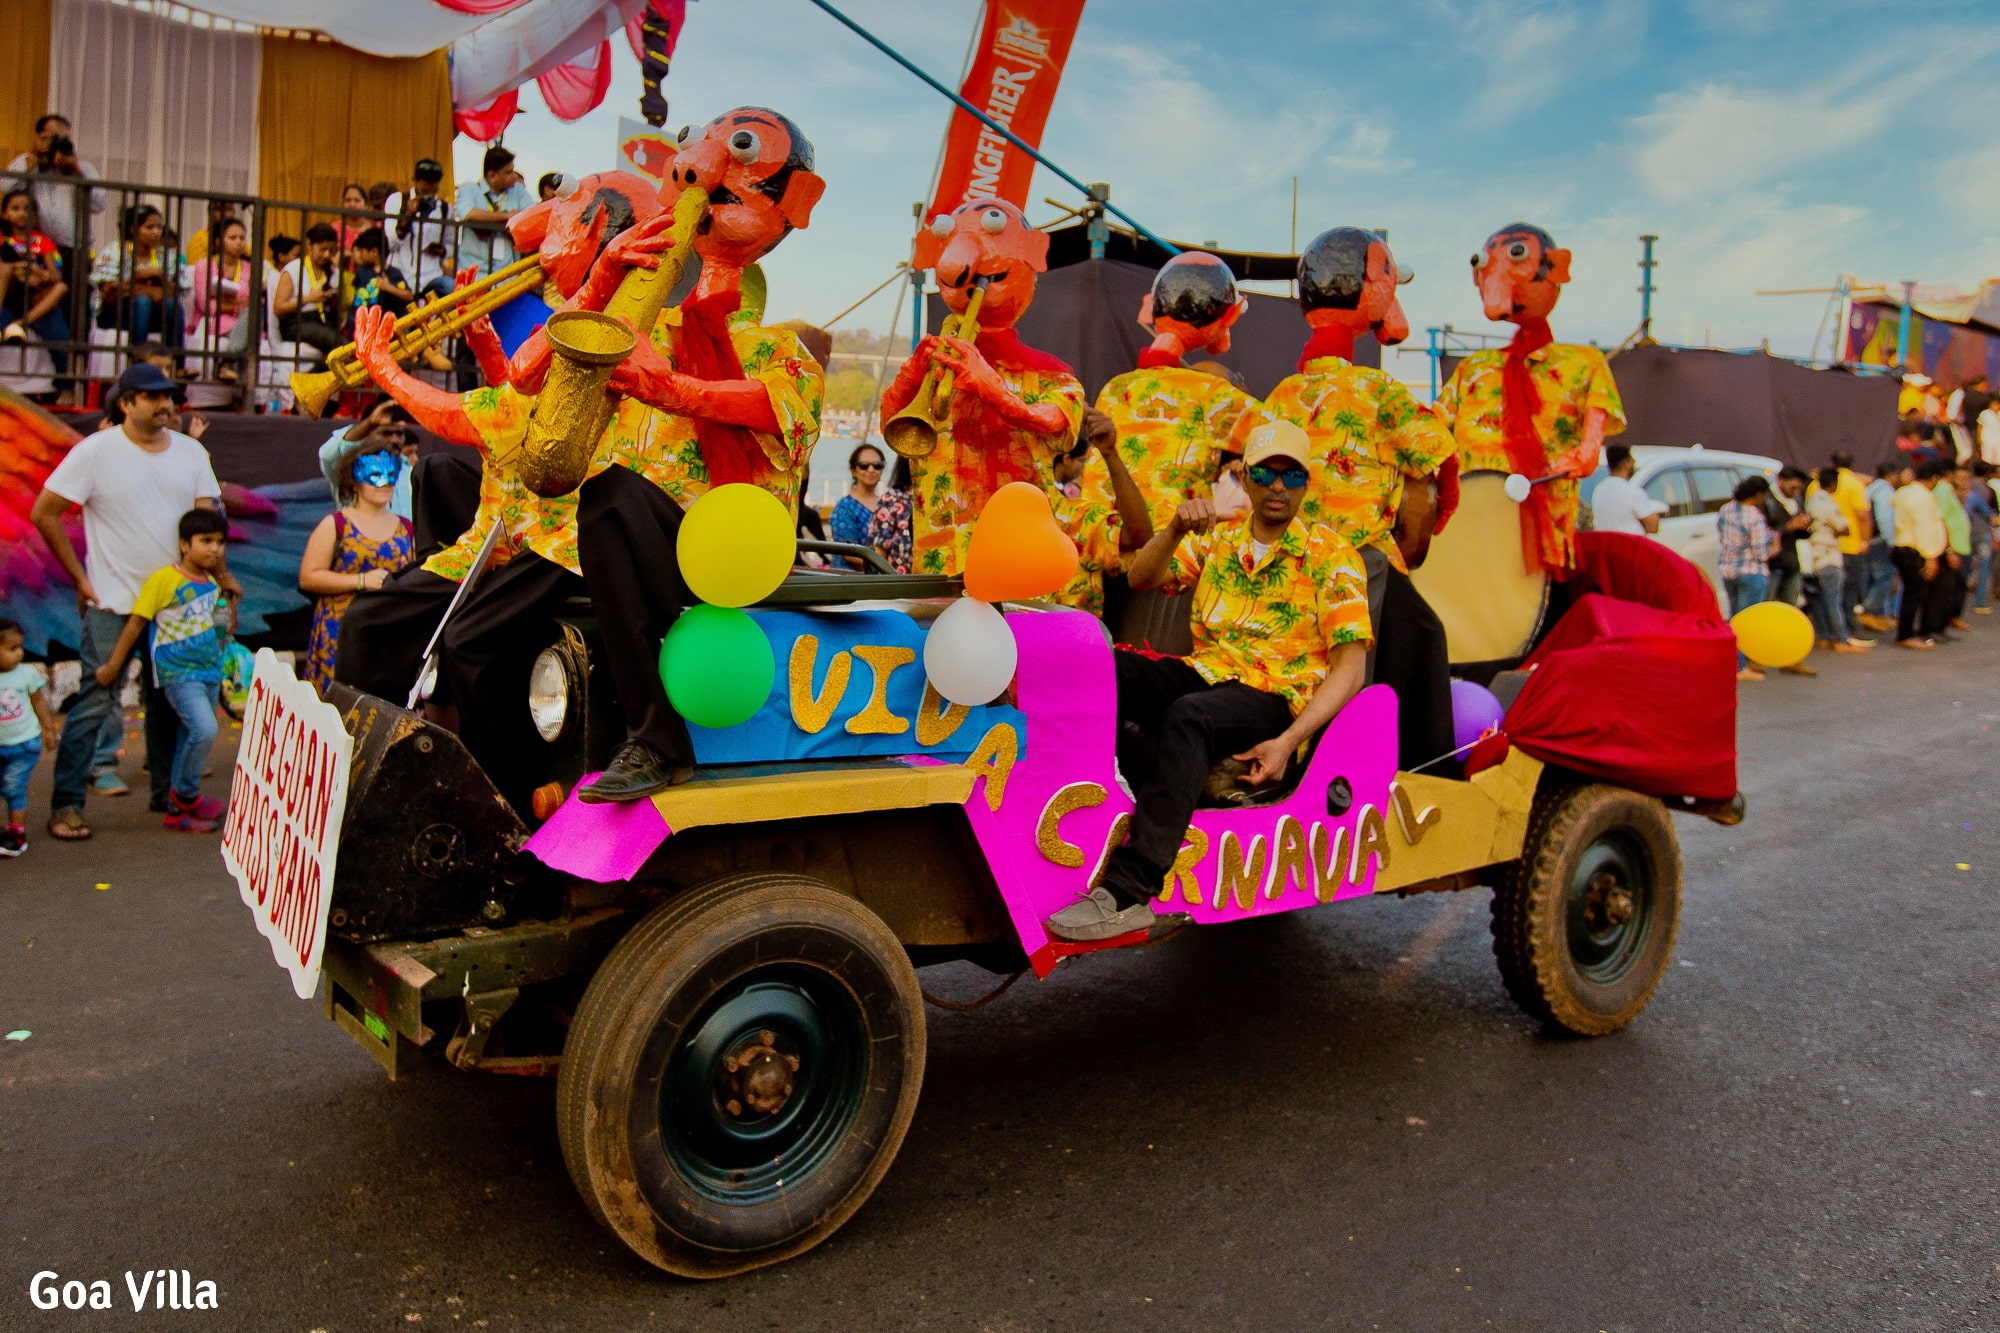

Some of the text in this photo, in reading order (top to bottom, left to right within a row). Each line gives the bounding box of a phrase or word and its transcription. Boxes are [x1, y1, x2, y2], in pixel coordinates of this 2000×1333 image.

[247, 677, 337, 854] THE GOAN
[223, 763, 320, 968] BRASS BAND
